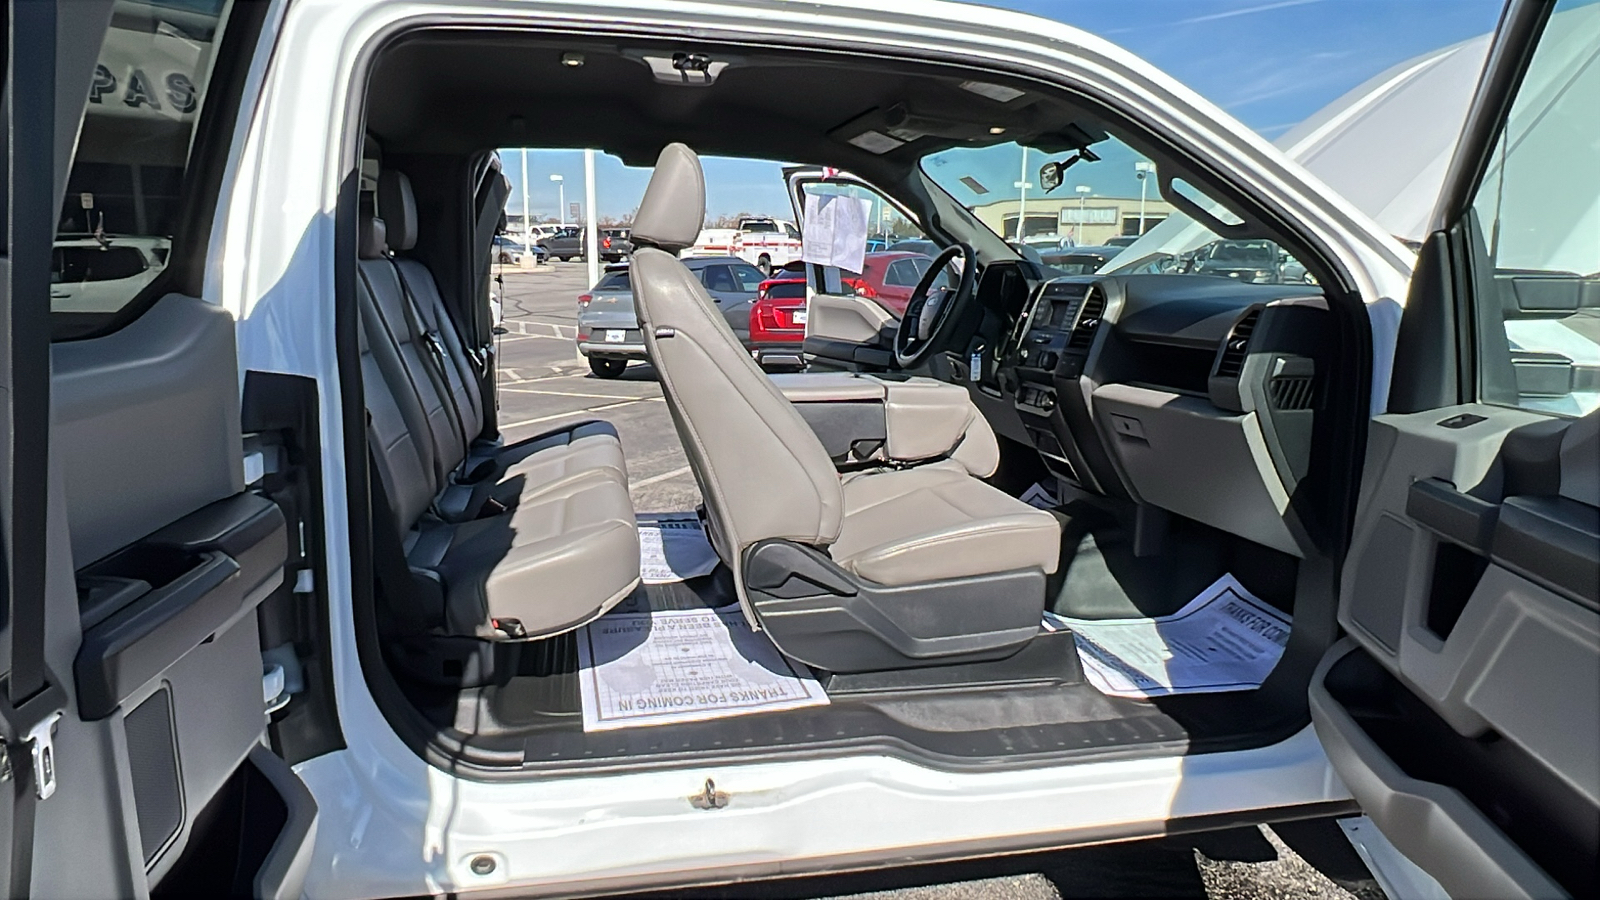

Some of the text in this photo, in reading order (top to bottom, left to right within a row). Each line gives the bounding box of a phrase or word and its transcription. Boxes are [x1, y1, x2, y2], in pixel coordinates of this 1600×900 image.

[659, 616, 699, 625] SERVE
[701, 616, 719, 624] TO
[679, 622, 712, 631] BEEN
[618, 686, 788, 711] THANKS FOR COMING IN
